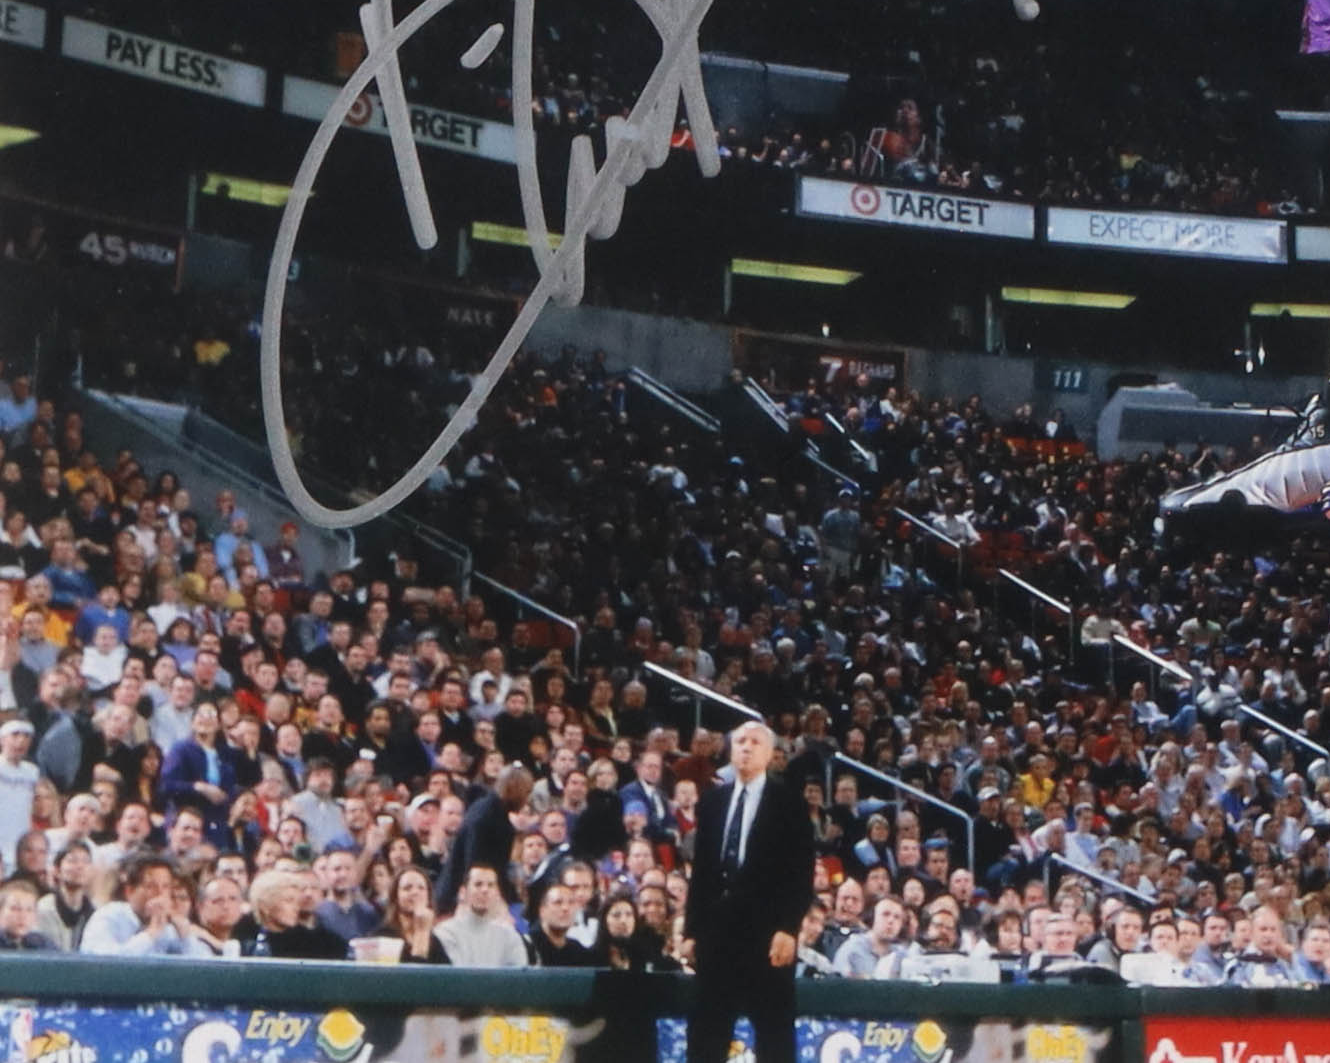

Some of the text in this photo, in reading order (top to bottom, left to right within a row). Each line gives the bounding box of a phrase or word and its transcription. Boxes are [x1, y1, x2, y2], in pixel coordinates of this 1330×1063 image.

[106, 32, 153, 67] PAY
[886, 190, 990, 226] TARGET
[1089, 214, 1237, 248] EXPECT MORE
[80, 232, 127, 266] 45
[1053, 369, 1082, 388] 111
[1310, 424, 1325, 438] 15
[245, 1010, 313, 1049] Enjoy
[862, 1020, 910, 1053] Enjoy
